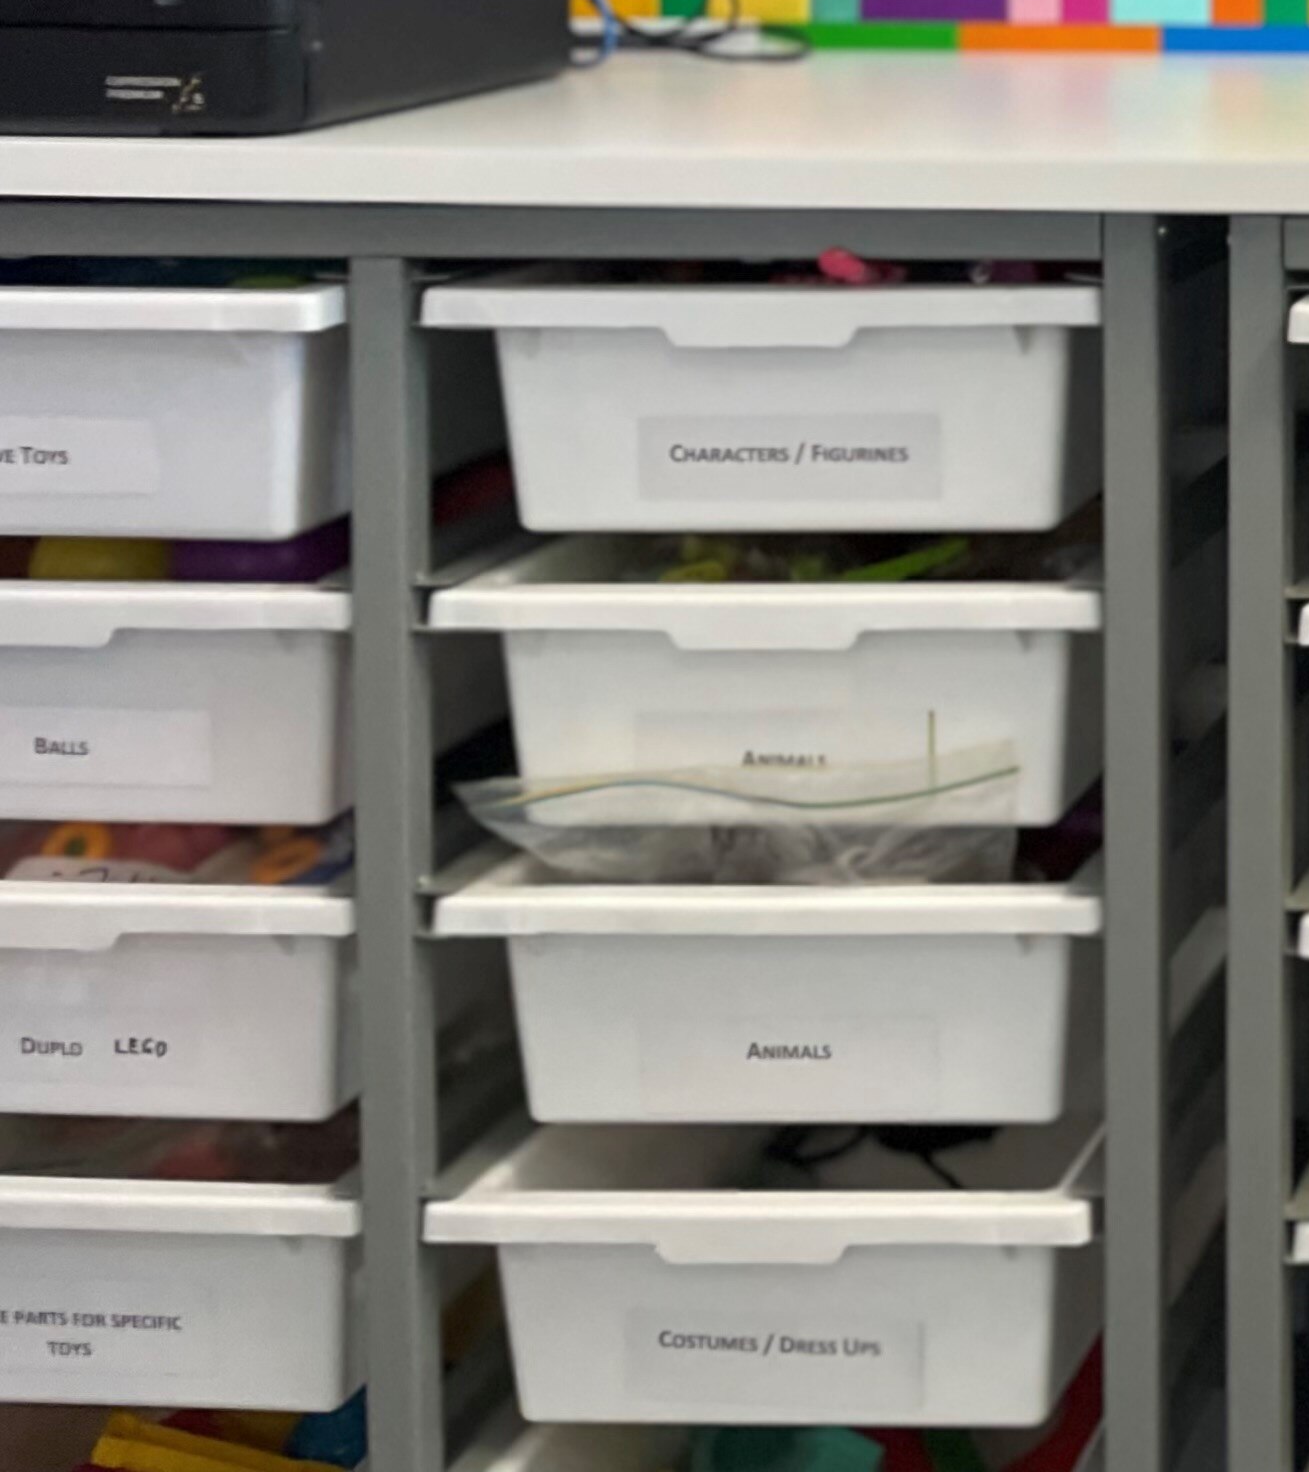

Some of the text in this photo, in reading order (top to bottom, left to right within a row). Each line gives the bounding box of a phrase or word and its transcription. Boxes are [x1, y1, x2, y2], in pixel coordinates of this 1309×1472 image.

[13, 1310, 68, 1326] PARTS
[72, 1312, 106, 1328] FOR
[111, 1314, 182, 1330] SPECIFIC
[47, 1340, 92, 1357] TOYS
